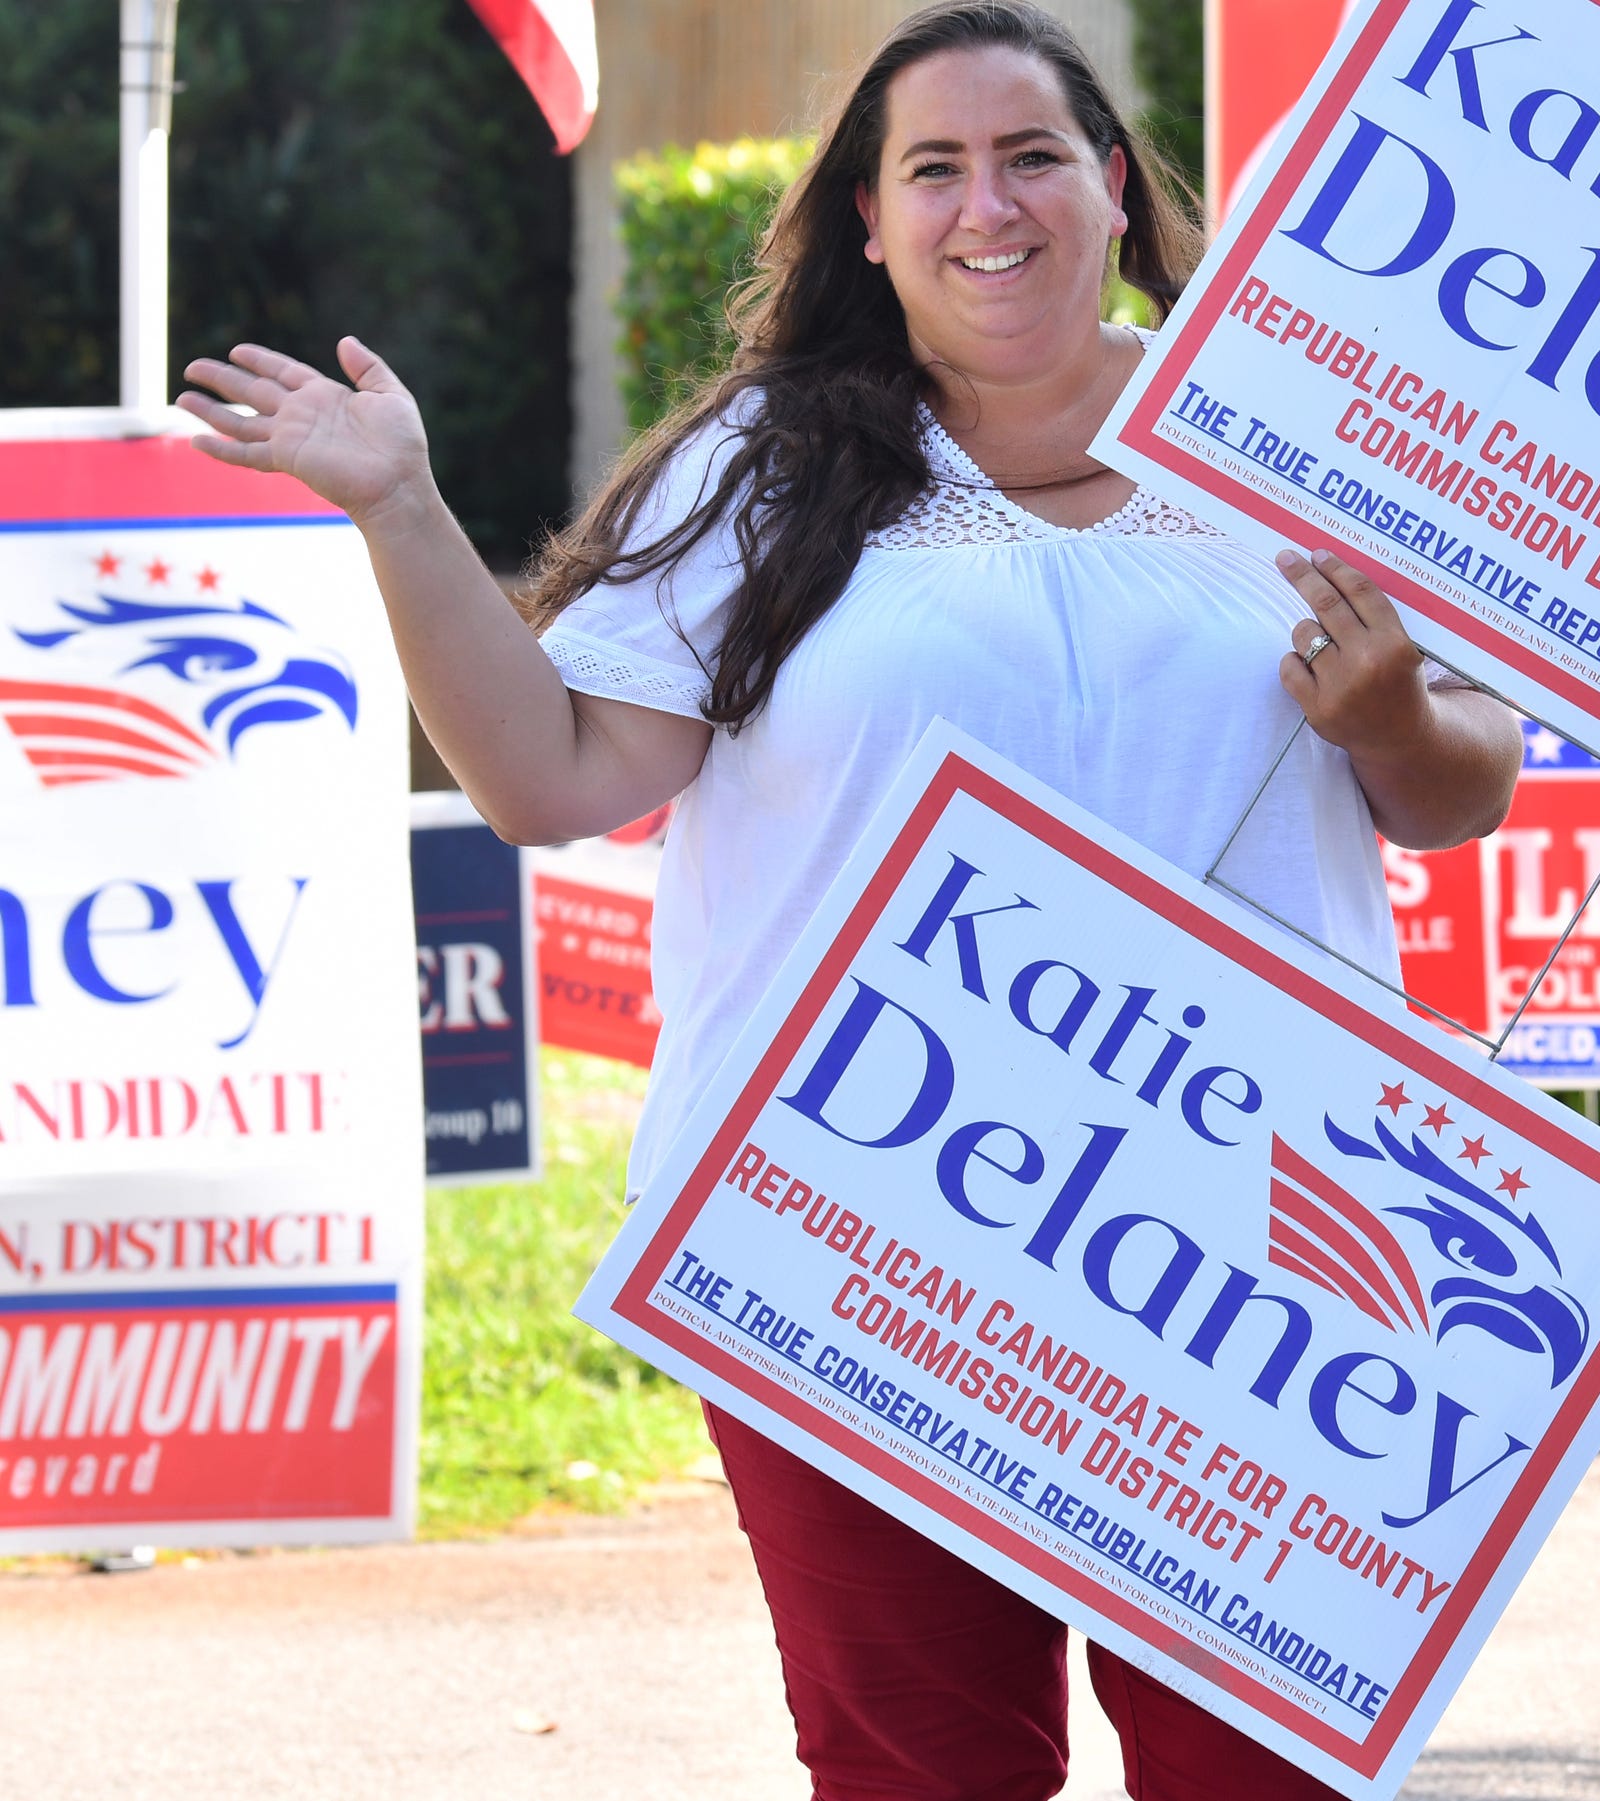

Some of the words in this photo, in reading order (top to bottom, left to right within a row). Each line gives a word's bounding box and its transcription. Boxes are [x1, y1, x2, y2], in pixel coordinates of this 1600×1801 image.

[1229, 276, 1479, 445] REPUBLICAN
[1160, 422, 1217, 462] POLITICAL
[1220, 458, 1312, 515] ADVERTISEMENT
[1312, 511, 1341, 531] PAID
[1341, 526, 1365, 544] FOR
[1365, 539, 1391, 558] AND
[1390, 554, 1452, 594] APPROVED
[1452, 589, 1470, 606] BY
[1469, 600, 1505, 627] KATIE
[1504, 620, 1559, 660] DELANEY,
[1178, 382, 1237, 438] THE
[1241, 418, 1318, 484] TRUE
[1319, 469, 1541, 613] CONSERVATIVE
[1335, 399, 1585, 570] COMMISSION
[0, 876, 310, 1050] ey
[893, 851, 1262, 1146] Katie
[0, 1072, 351, 1143] NDIDATE
[60, 1213, 346, 1274] DISTRICT
[357, 1213, 375, 1263] 1
[776, 975, 1532, 1528] Delaney
[0, 1315, 391, 1441] MMUNITY
[0, 1442, 162, 1498] evard
[673, 1250, 733, 1310] THE
[734, 1290, 814, 1361] TRUE
[813, 1346, 1037, 1499] CONSERVATIVE
[1035, 1483, 1220, 1613] REPUBLICAN
[1220, 1594, 1389, 1717] CANDIDATE
[725, 1143, 976, 1325] REPUBLICAN
[976, 1300, 1203, 1466] CANDIDATE
[1201, 1443, 1287, 1519] FOR
[1289, 1494, 1451, 1613] COUNTY
[832, 1274, 1082, 1455] COMMISSION
[1080, 1428, 1263, 1563] DISTRICT
[1264, 1540, 1293, 1583] 1
[654, 1291, 713, 1334] POLITICAL
[713, 1330, 807, 1391] ADVERTISEMENT
[808, 1387, 835, 1410] PAID
[835, 1404, 860, 1427] FOR
[860, 1420, 885, 1441] AND
[885, 1437, 946, 1479] APPROVED
[946, 1473, 965, 1491] BY
[964, 1485, 999, 1514] KATIE
[999, 1506, 1054, 1546] DELANEY,
[1054, 1540, 1125, 1589] REPUBLICAN
[1125, 1584, 1150, 1606] FOR
[1149, 1598, 1197, 1634] COUNTY
[1196, 1628, 1269, 1680] COMMISSION,
[1268, 1672, 1322, 1712] DISTRICT
[1319, 1704, 1328, 1716] 1
